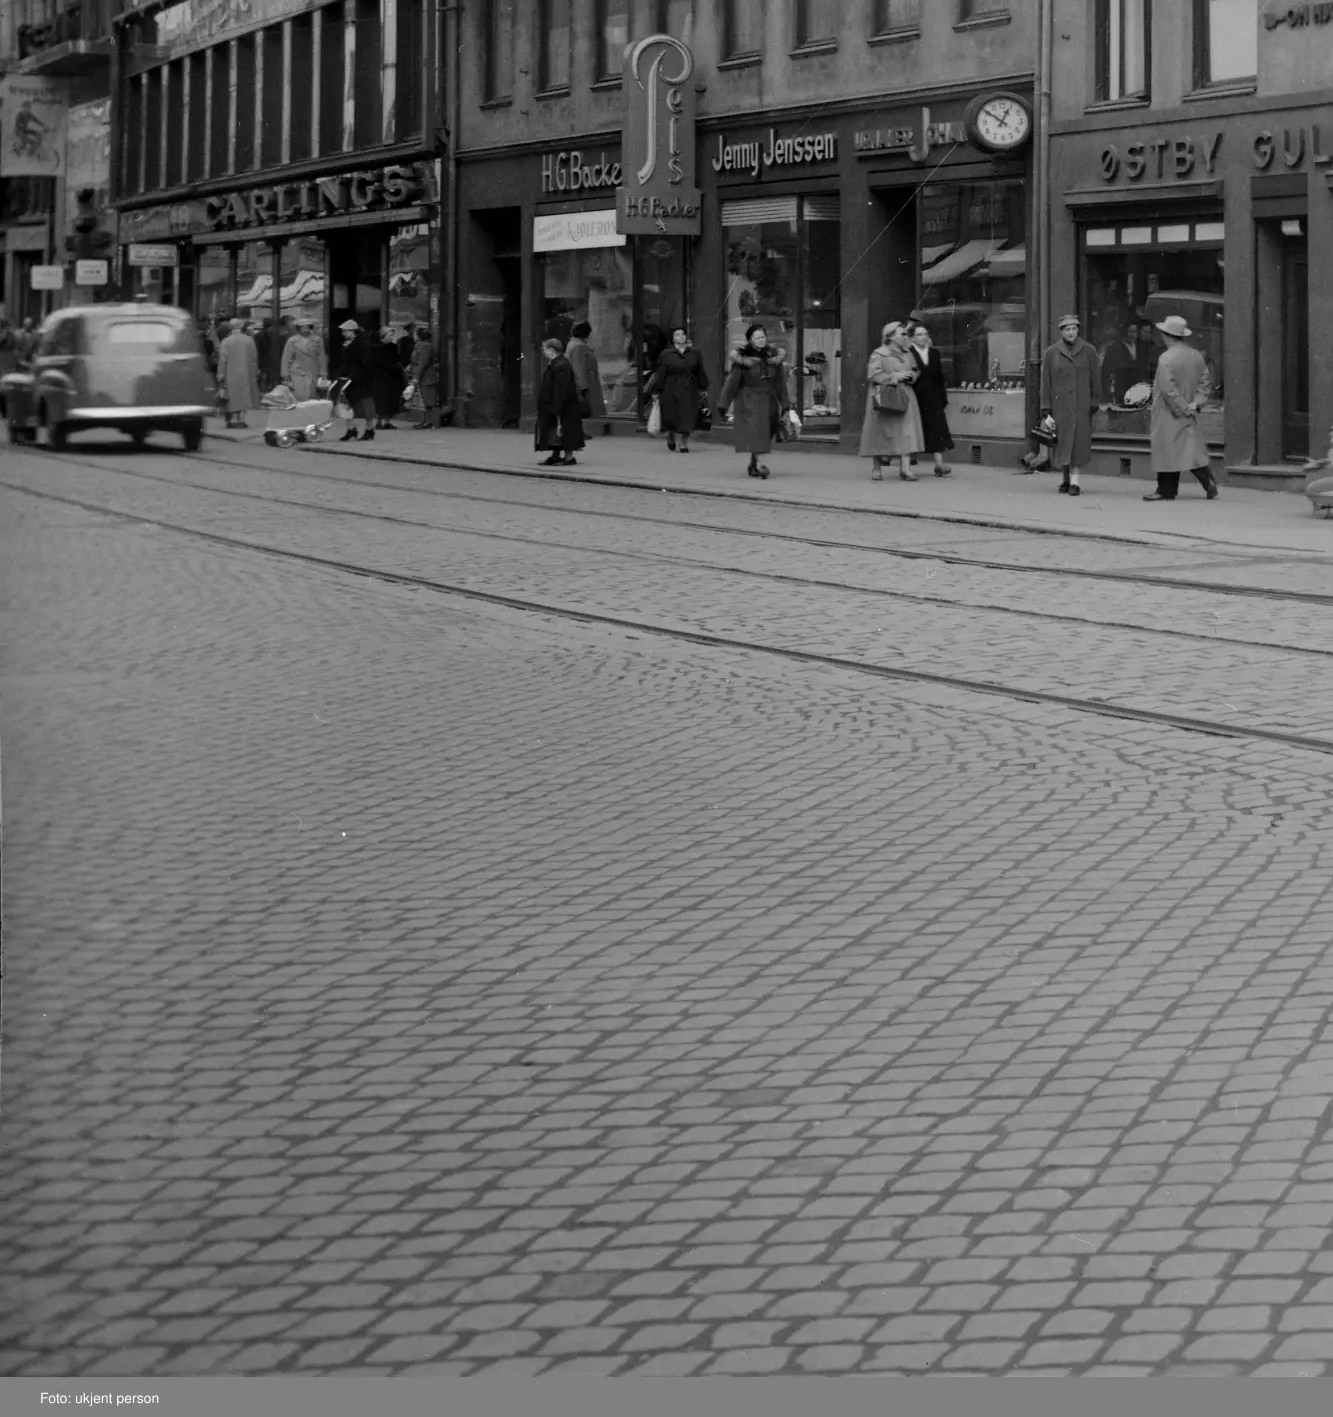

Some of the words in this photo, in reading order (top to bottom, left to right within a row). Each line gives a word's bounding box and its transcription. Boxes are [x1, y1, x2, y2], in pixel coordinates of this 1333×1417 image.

[711, 134, 758, 176] Jenny
[762, 128, 836, 165] Jenssen
[1100, 132, 1223, 181] ØSTBY
[204, 166, 414, 229] CARLINGS
